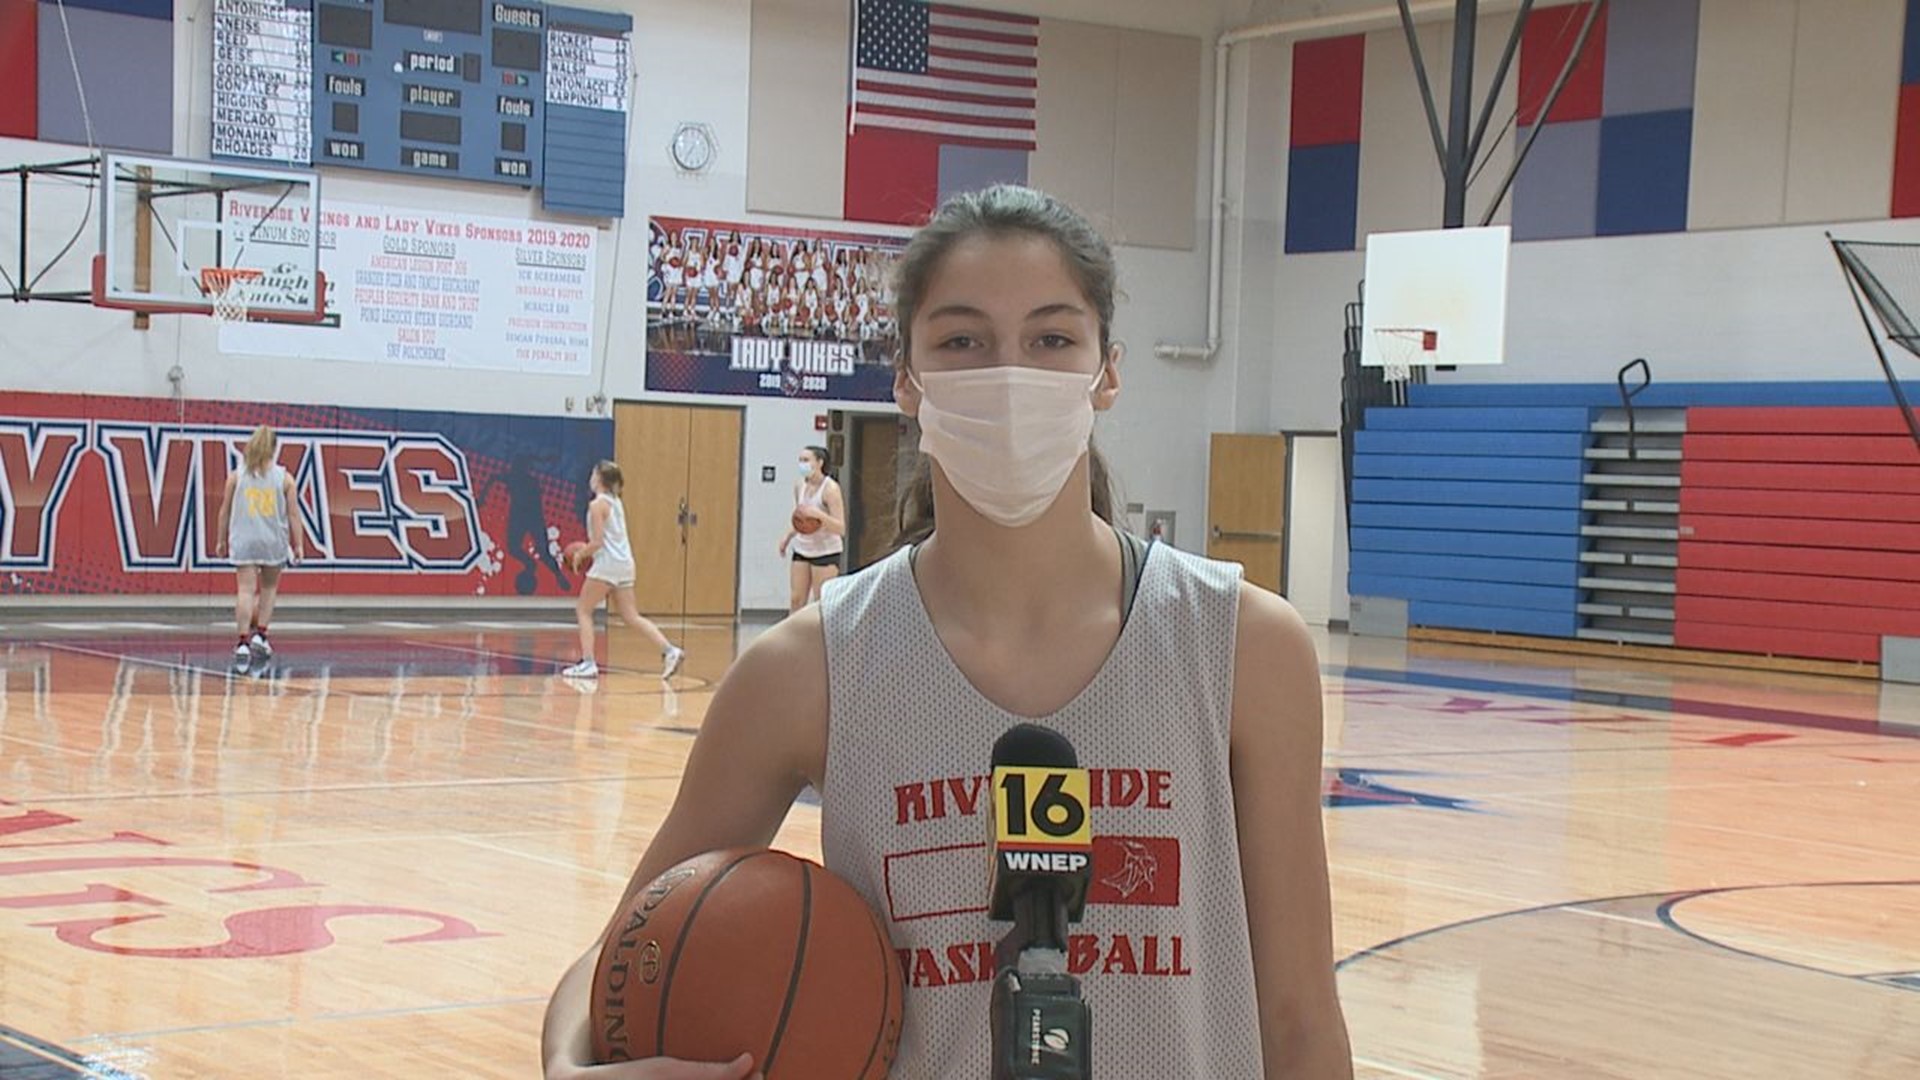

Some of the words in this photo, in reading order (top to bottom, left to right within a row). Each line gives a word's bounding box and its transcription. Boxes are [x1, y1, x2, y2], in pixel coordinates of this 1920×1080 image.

[495, 5, 541, 27] Guests
[217, 30, 249, 46] REED
[550, 31, 593, 49] RICKERT
[409, 51, 456, 73] period
[550, 47, 596, 64] SAMSELL
[216, 62, 287, 83] GODLEWSKI
[551, 62, 586, 76] WALSH
[215, 77, 279, 98] GONZALEZ
[328, 77, 362, 97] fouls
[408, 84, 454, 107] player
[217, 91, 268, 111] HIGGINS
[500, 96, 531, 118] fouls
[217, 108, 276, 127] MERCADO
[216, 125, 278, 144] MONAHAN
[215, 138, 273, 157] RHOADES
[330, 141, 359, 158] won
[412, 150, 448, 168] game
[500, 159, 527, 176] won
[230, 200, 294, 221] RIVERSIDE
[355, 214, 380, 230] AND
[385, 215, 419, 233] LADY
[425, 218, 460, 238] VIKES
[466, 223, 523, 243] SPONSORS
[383, 235, 408, 251] GOLD
[729, 334, 785, 371] LADY
[790, 338, 856, 375] VIKES
[759, 373, 782, 389] 2019
[802, 375, 828, 392] 2020
[893, 769, 1172, 825] RIVIDE
[1000, 773, 1085, 838] 16
[1004, 851, 1089, 872] WNEP
[897, 933, 1192, 988] ASKBALL
